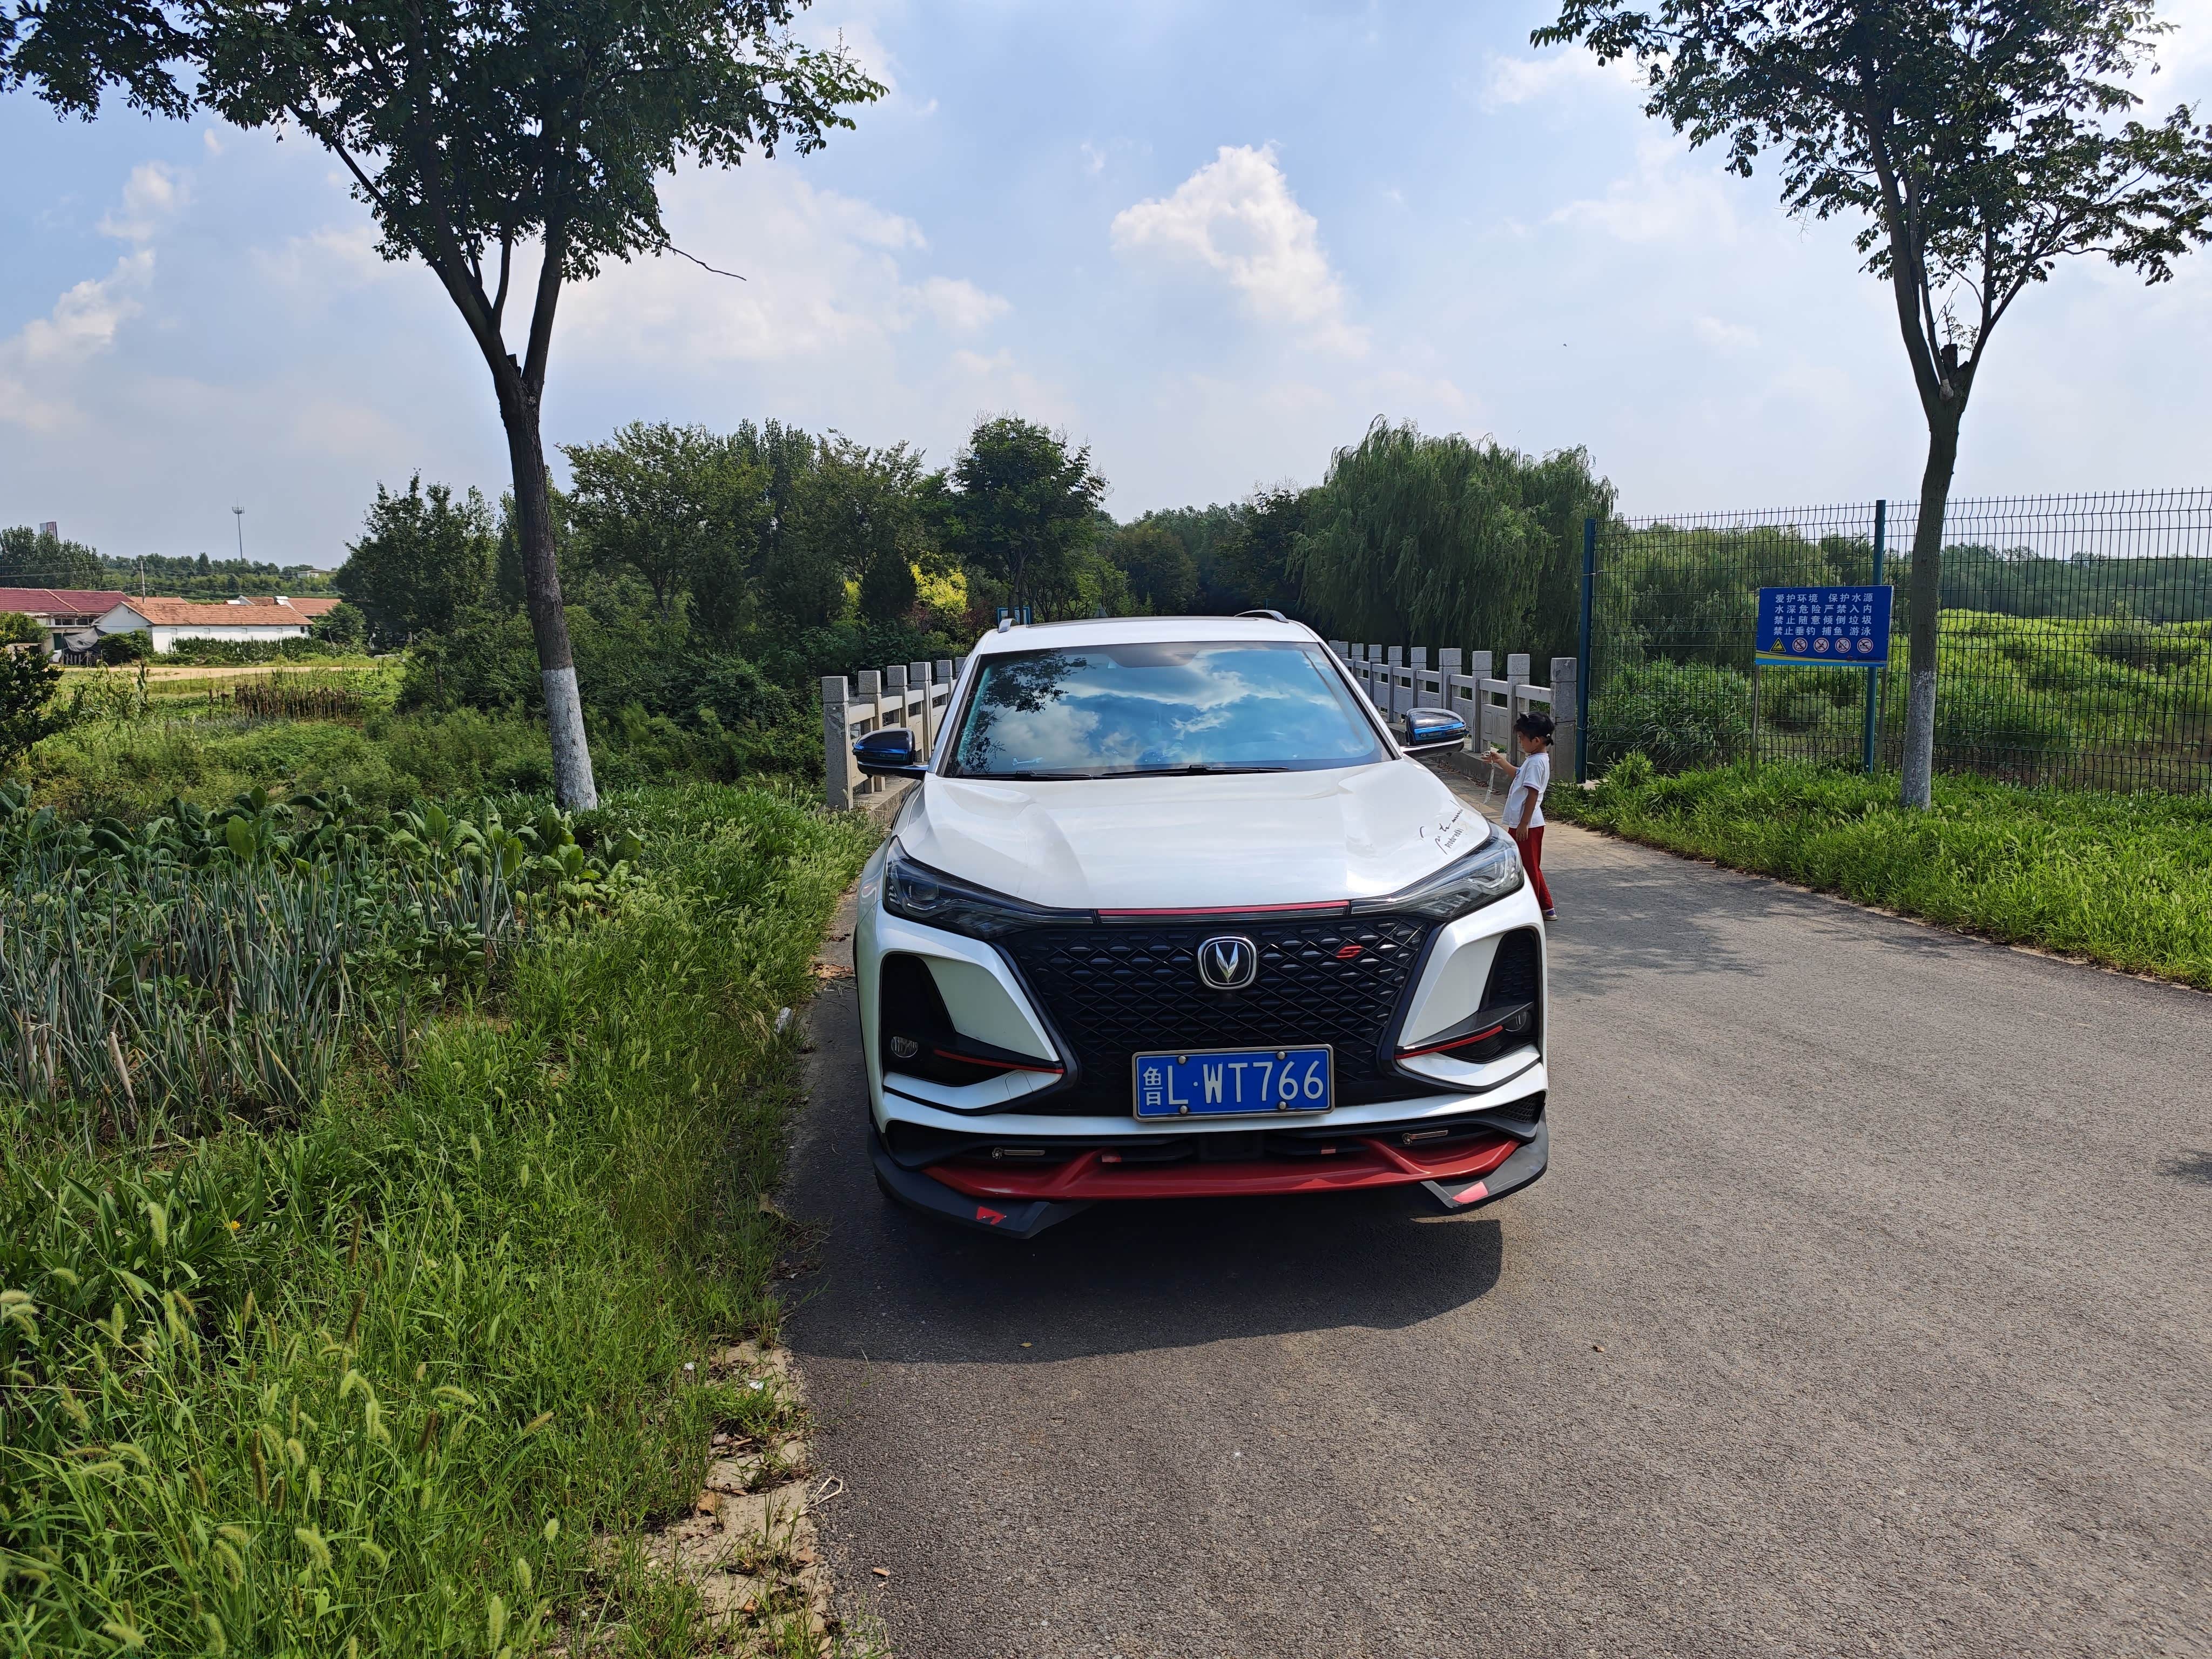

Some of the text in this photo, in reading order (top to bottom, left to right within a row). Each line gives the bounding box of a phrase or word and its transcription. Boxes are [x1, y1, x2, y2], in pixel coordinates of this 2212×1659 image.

[1775, 593, 1873, 603] 爱护环境 保护水源
[1775, 604, 1872, 614] 水深危险严禁入内
[1774, 615, 1872, 625] 禁止随意倾倒垃圾
[1773, 626, 1872, 636] 禁止垂钓 捕鱼 游泳
